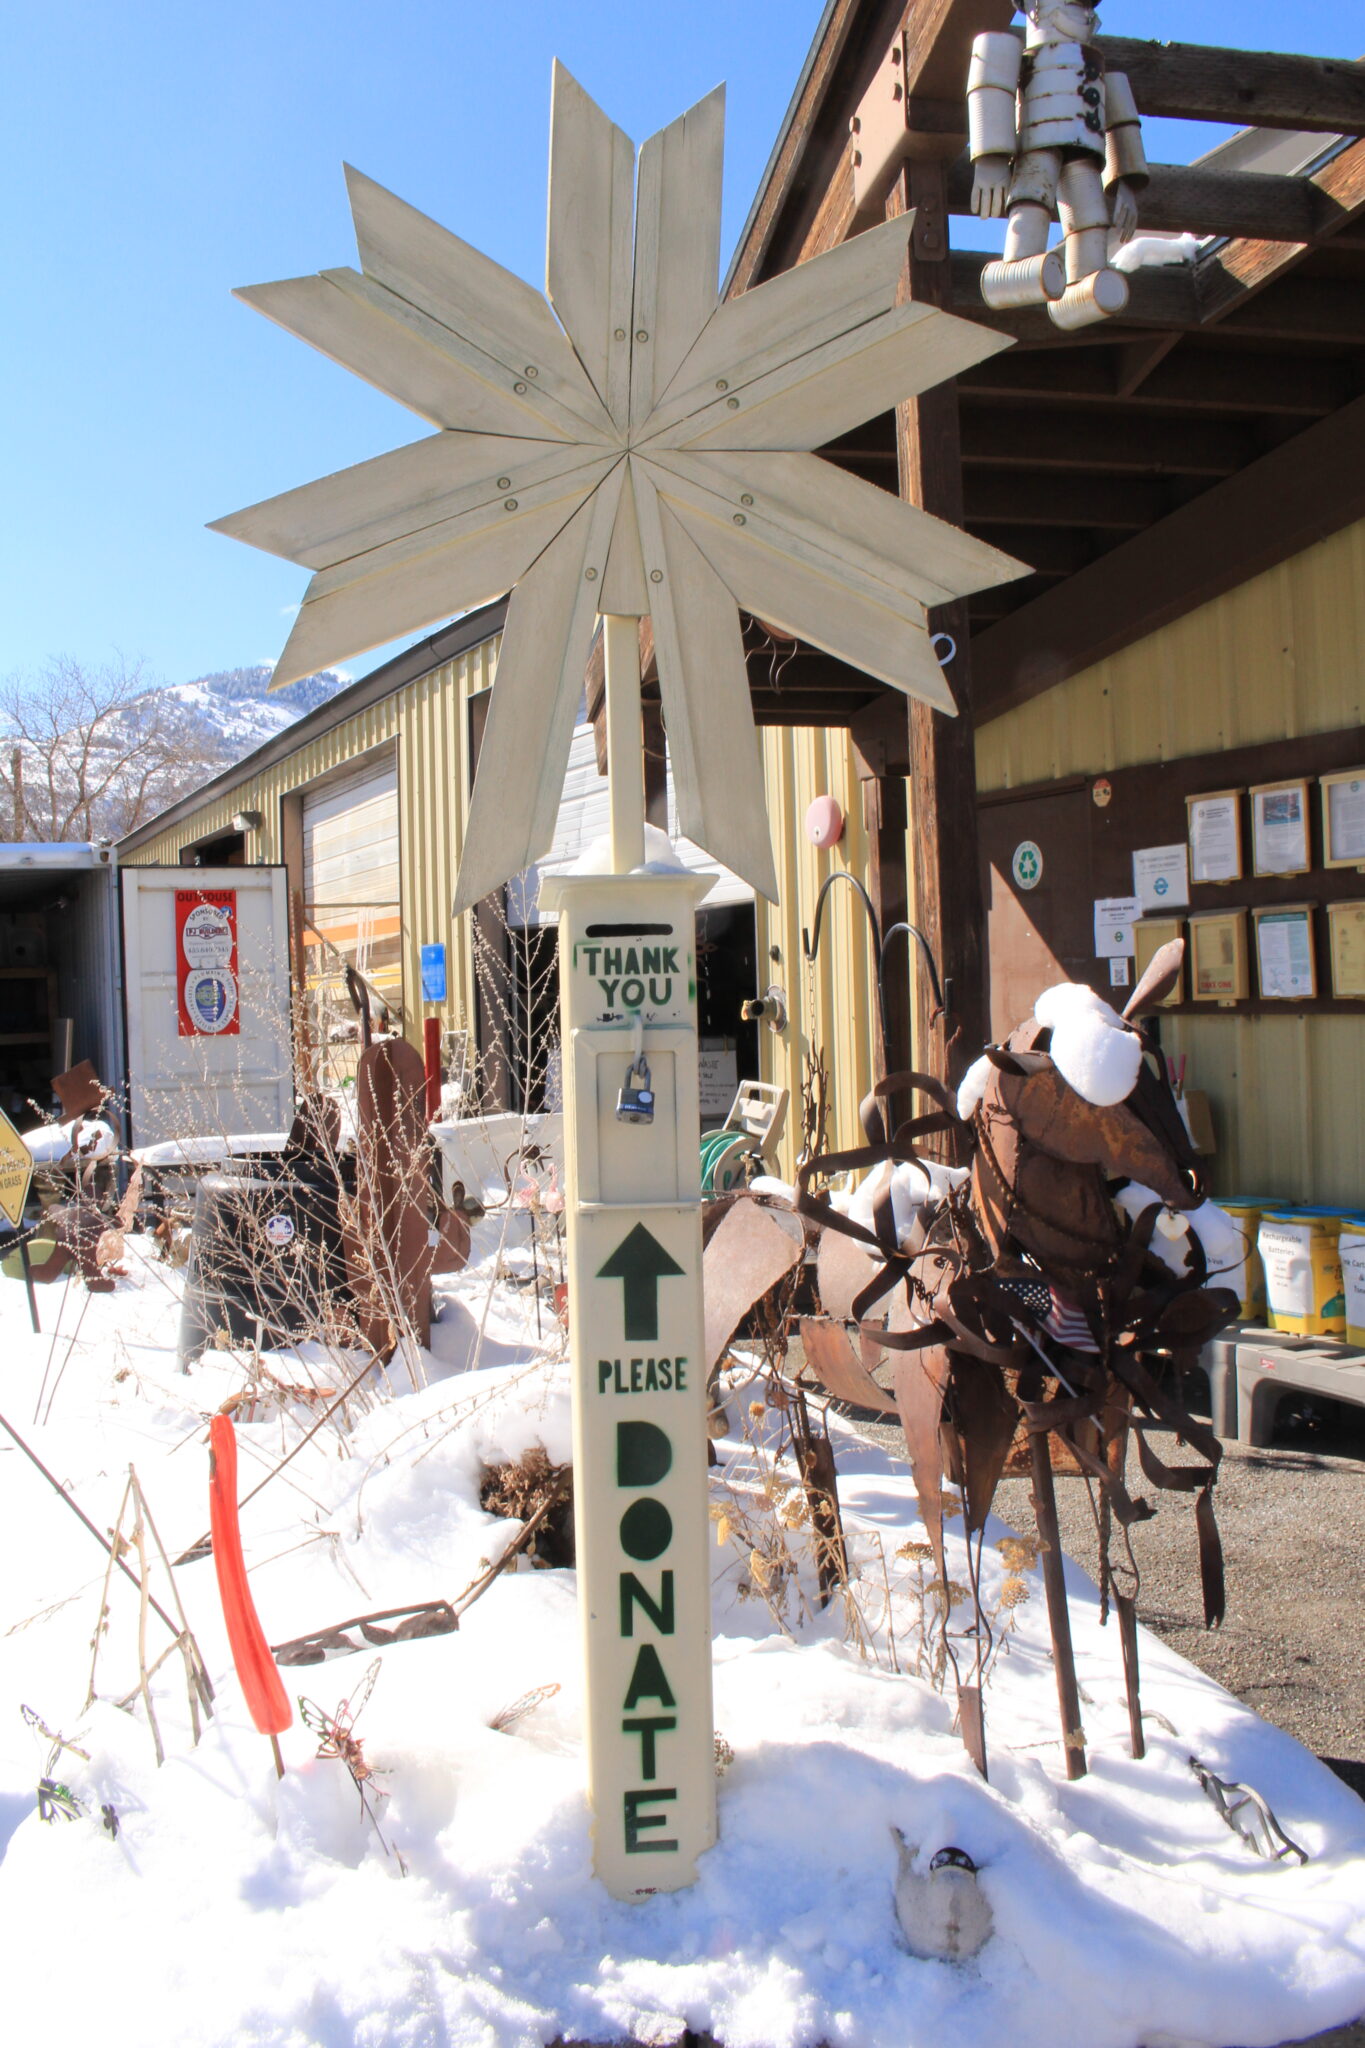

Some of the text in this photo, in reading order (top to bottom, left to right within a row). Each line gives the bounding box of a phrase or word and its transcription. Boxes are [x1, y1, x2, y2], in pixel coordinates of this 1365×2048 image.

[583, 946, 681, 977] THANK
[597, 977, 673, 1009] YOU
[1262, 1231, 1302, 1244] Rechargeable
[1268, 1246, 1295, 1256] Batteries
[599, 1357, 688, 1393] PLEASE
[617, 1421, 678, 1854] DONATE
